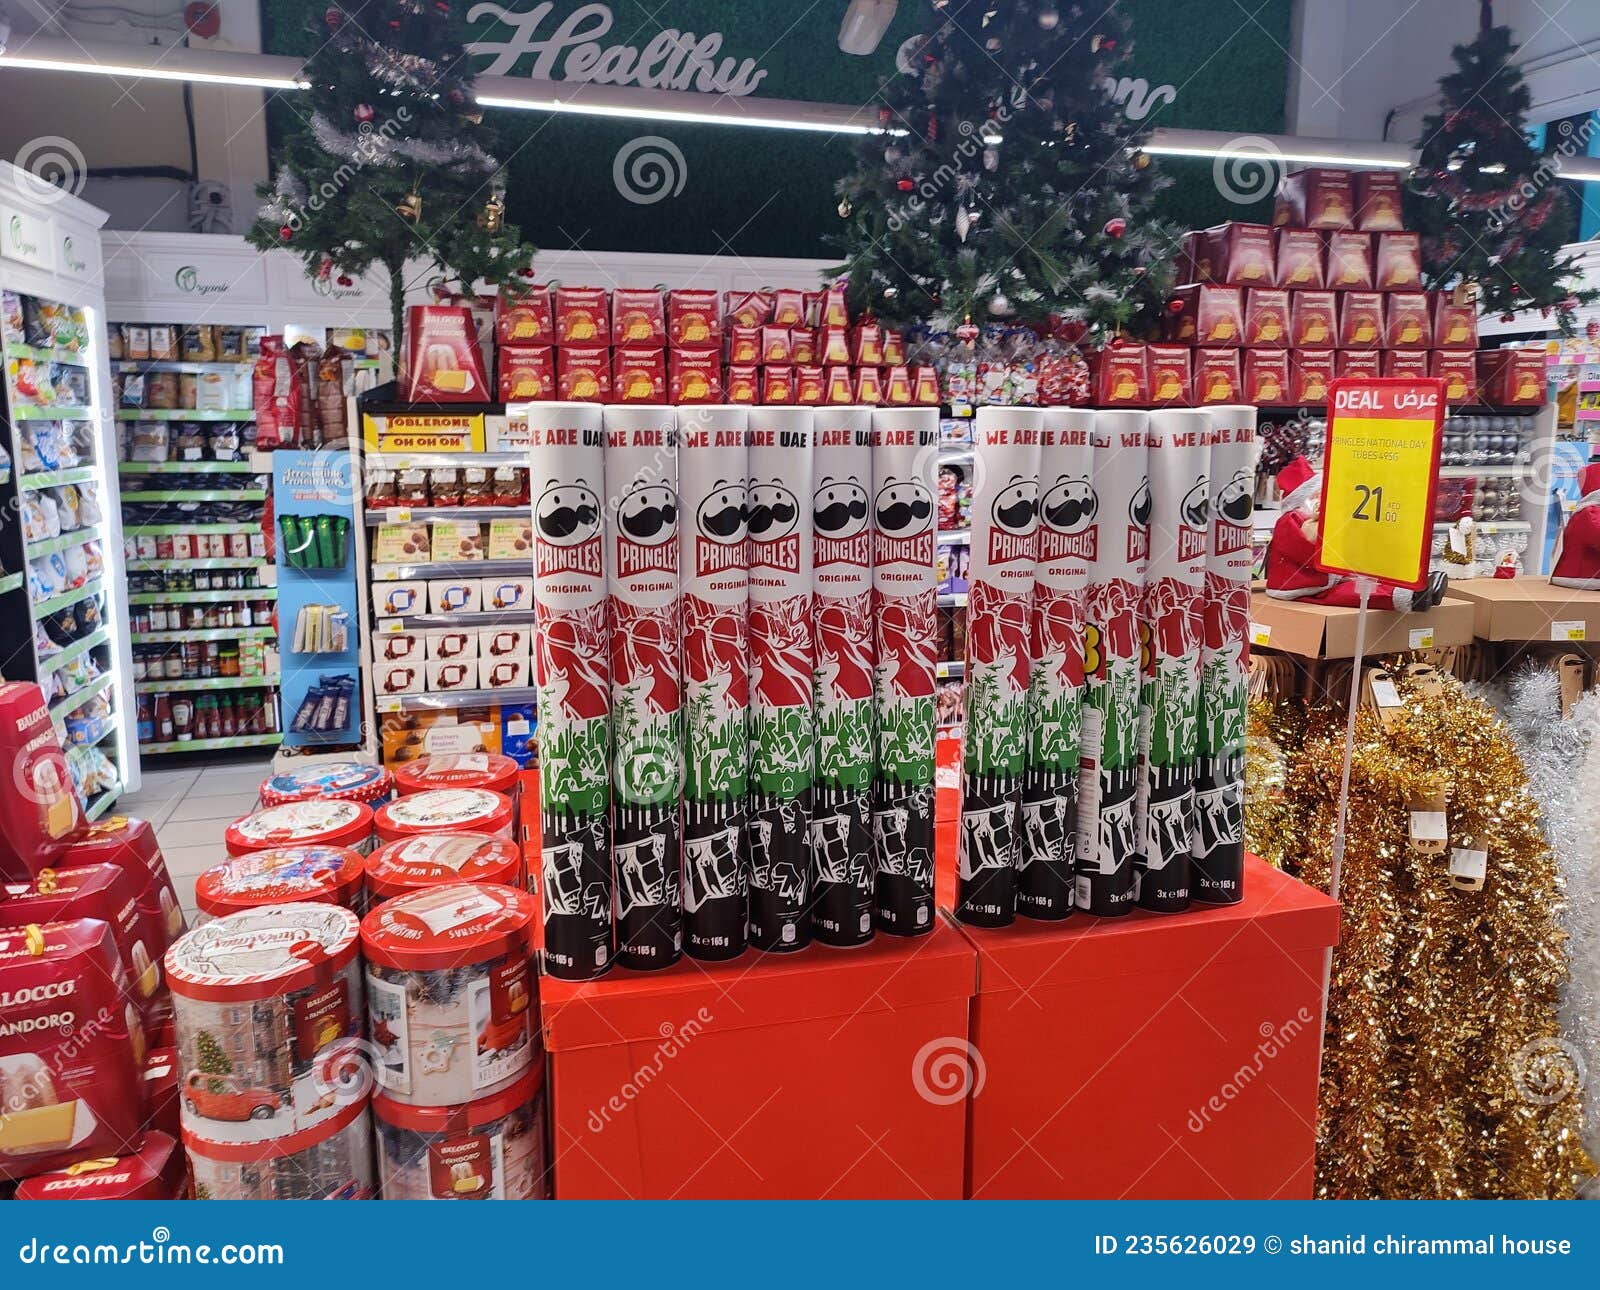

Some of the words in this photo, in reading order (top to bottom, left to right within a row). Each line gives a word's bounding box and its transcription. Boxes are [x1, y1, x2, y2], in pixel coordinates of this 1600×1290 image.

[464, 1, 767, 95] Healthy
[1335, 391, 1384, 410] DEAL
[1393, 389, 1438, 409] عرض
[386, 416, 470, 429] TOBLERONE
[394, 438, 413, 446] OH
[416, 438, 433, 446] OH
[439, 438, 461, 446] OH
[546, 429, 577, 446] ARE
[607, 431, 627, 448] WE
[632, 430, 663, 447] ARE
[686, 431, 709, 448] WE
[714, 431, 742, 447] ARE
[749, 431, 775, 447] ARE
[780, 431, 807, 449] UAE
[822, 431, 851, 446] ARE
[886, 430, 915, 447] ARE
[986, 430, 1008, 447] WE
[1013, 430, 1038, 447] ARE
[1060, 430, 1086, 447] ARE
[1120, 433, 1141, 448] WE
[1172, 432, 1195, 448] WE
[1366, 438, 1408, 449] NATIONAL
[1410, 439, 1428, 450] DAY
[1352, 450, 1378, 460] TUBES
[1352, 484, 1383, 523] 21
[1385, 512, 1397, 522] 00
[875, 533, 933, 564] PRINGLES
[538, 541, 601, 574] PRINGLES
[819, 574, 862, 583] ORIGINAL
[880, 573, 923, 582] ORIGINAL
[545, 584, 593, 594] ORIGINAL
[630, 582, 673, 593] ORIGINAL
[42, 1172, 132, 1192] BALOCCO
